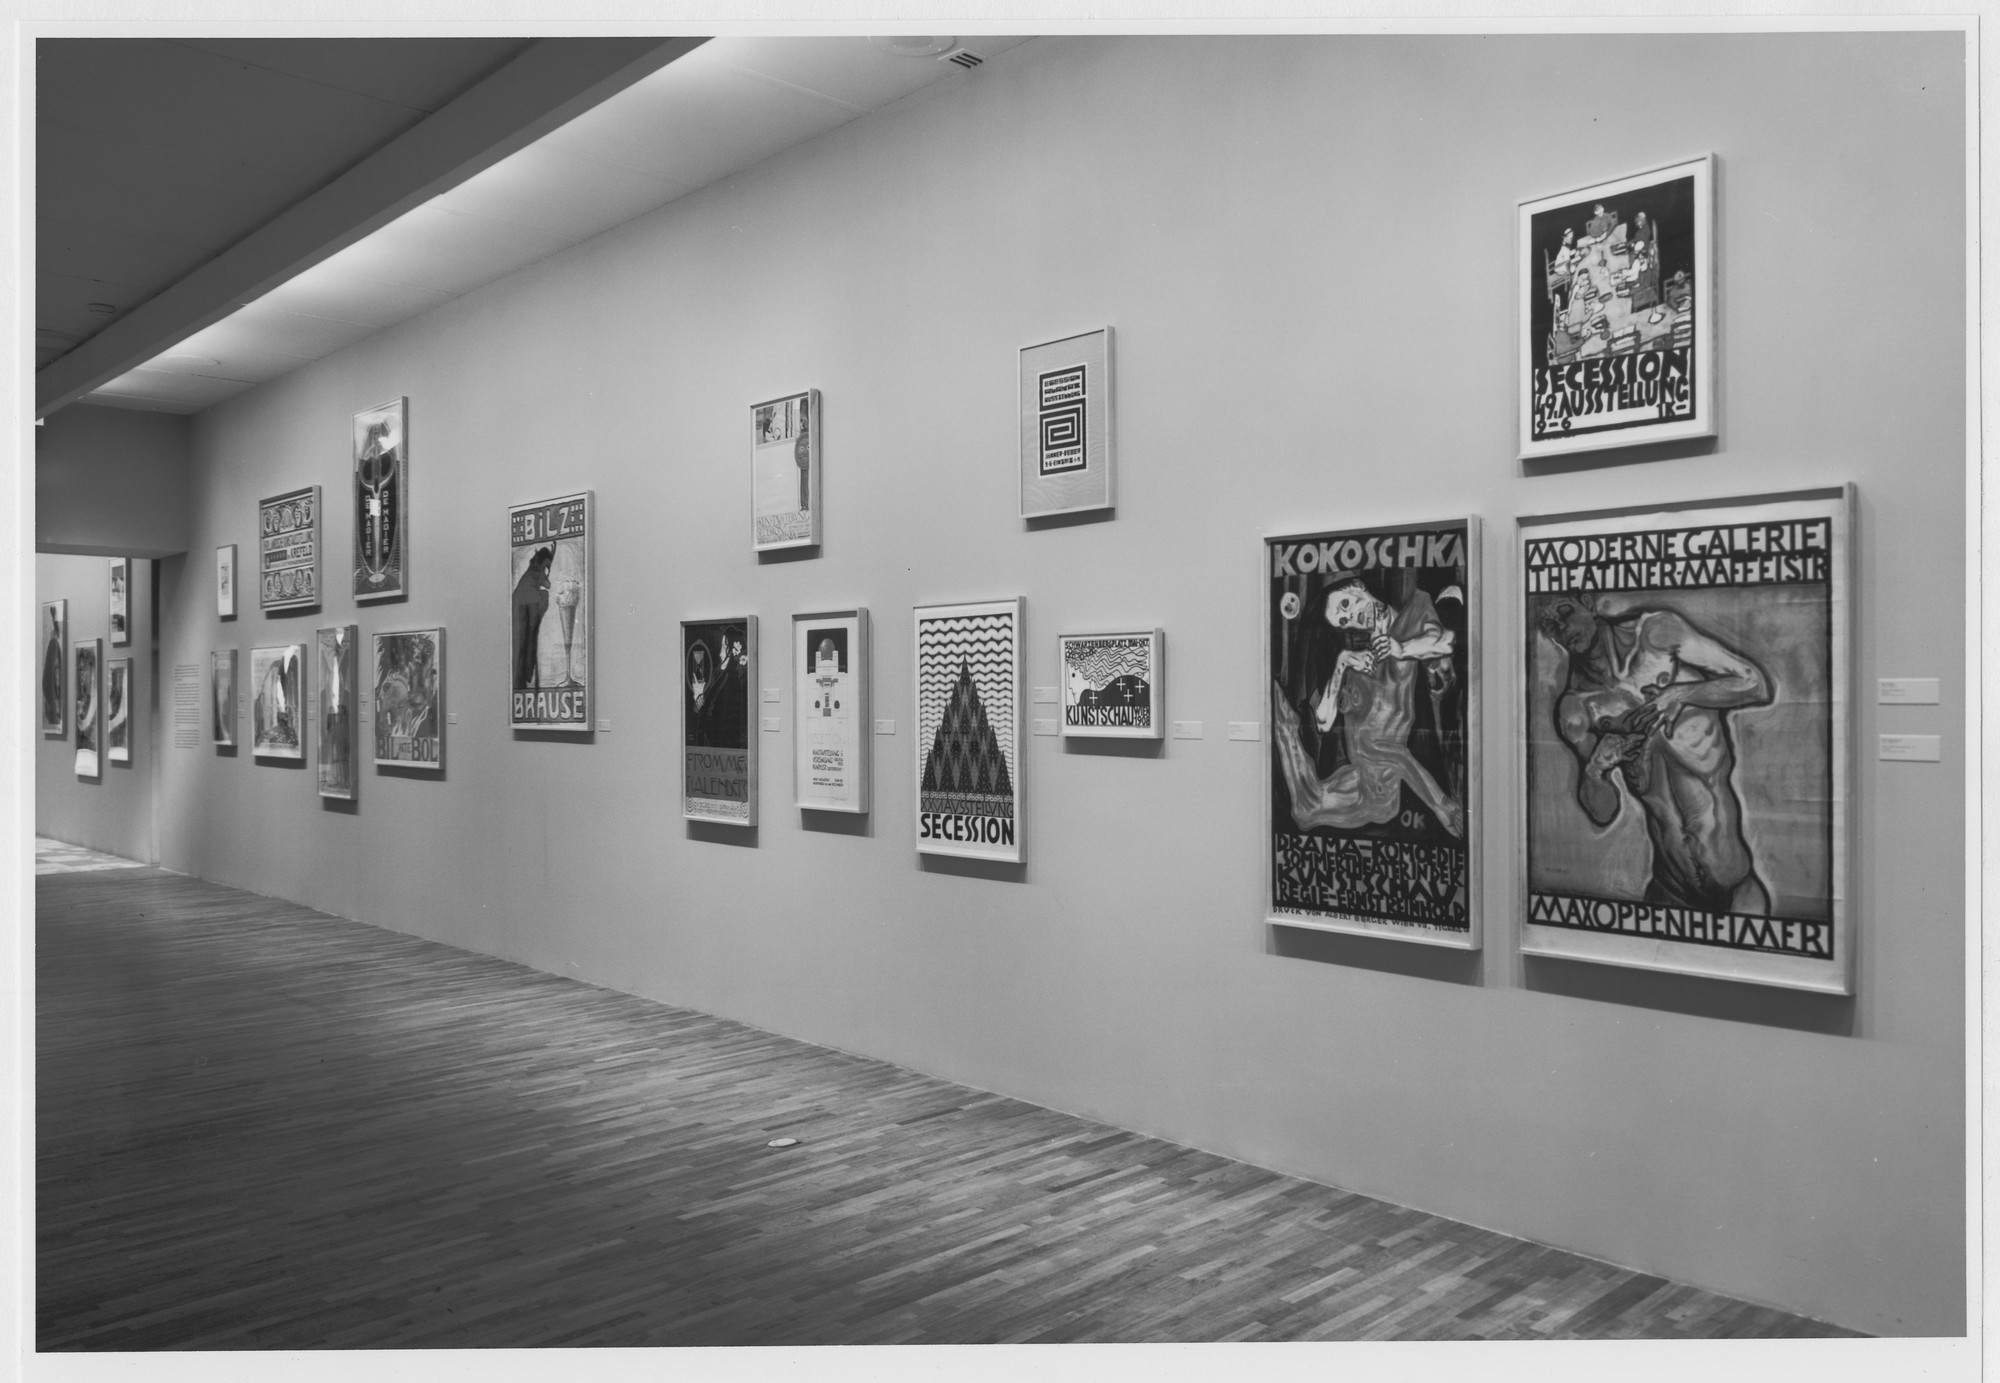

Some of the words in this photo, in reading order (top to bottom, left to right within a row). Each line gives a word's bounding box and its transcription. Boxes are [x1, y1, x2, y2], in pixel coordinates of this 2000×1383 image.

[1535, 348, 1688, 395] SECESSION
[1559, 375, 1688, 418] AUSSTELLUNG
[1273, 533, 1466, 578] KOKOSCHKA
[1528, 530, 1677, 566] MODERNE
[1683, 522, 1822, 554] GALERIE
[514, 691, 584, 719] BRAUSE
[1066, 705, 1133, 726] KUNSTSCHAU
[376, 736, 400, 760] BIL
[412, 738, 438, 762] BOL
[921, 812, 1014, 846] SECESSION
[1400, 810, 1426, 829] OK
[1273, 906, 1302, 915] DRUCK
[1593, 900, 1829, 954] OPPENHEIMER
